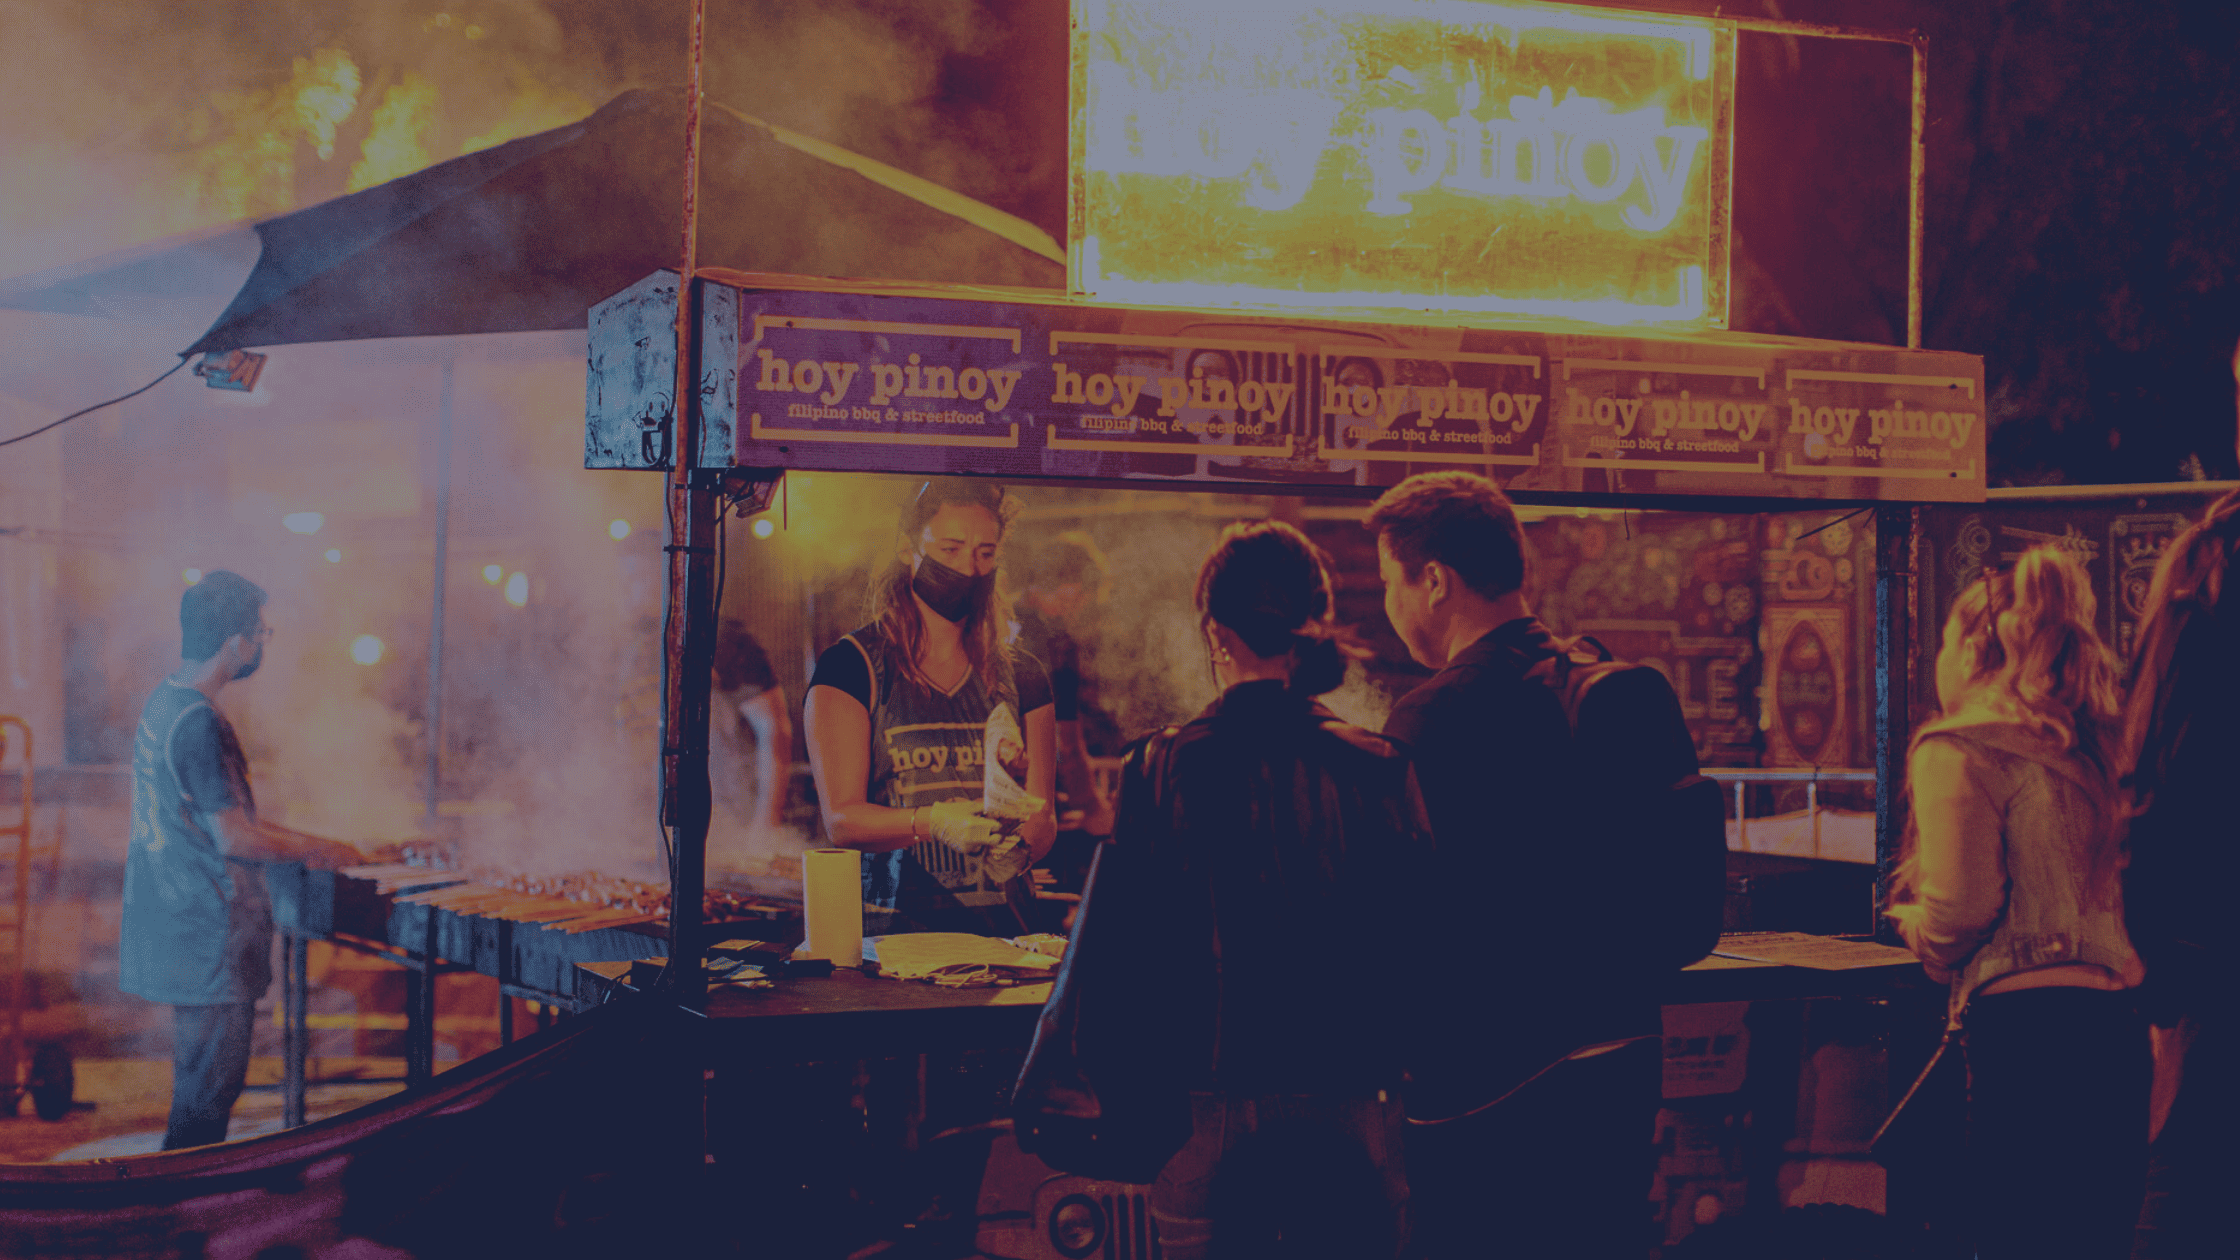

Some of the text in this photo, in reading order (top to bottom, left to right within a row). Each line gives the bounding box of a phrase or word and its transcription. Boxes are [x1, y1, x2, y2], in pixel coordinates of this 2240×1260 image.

[756, 348, 1023, 413] hoy pinoy
[1051, 363, 1296, 423] hoy pinoy
[787, 403, 986, 425] filipino bbq & streetfood
[1320, 376, 1543, 433] hoy pinoy
[1564, 387, 1767, 442] hoy pinoy
[1140, 418, 1168, 435] bbq
[1170, 419, 1183, 432] &
[1186, 420, 1263, 435] streetfood
[1401, 428, 1426, 444] bbq
[1429, 429, 1442, 442] &
[1443, 430, 1513, 444] streetfood
[1788, 398, 1977, 449] hoy pinoy
[1638, 437, 1662, 453] bbq
[1663, 438, 1674, 451] &
[1855, 445, 1877, 460] bbq
[888, 745, 949, 773] hoy
